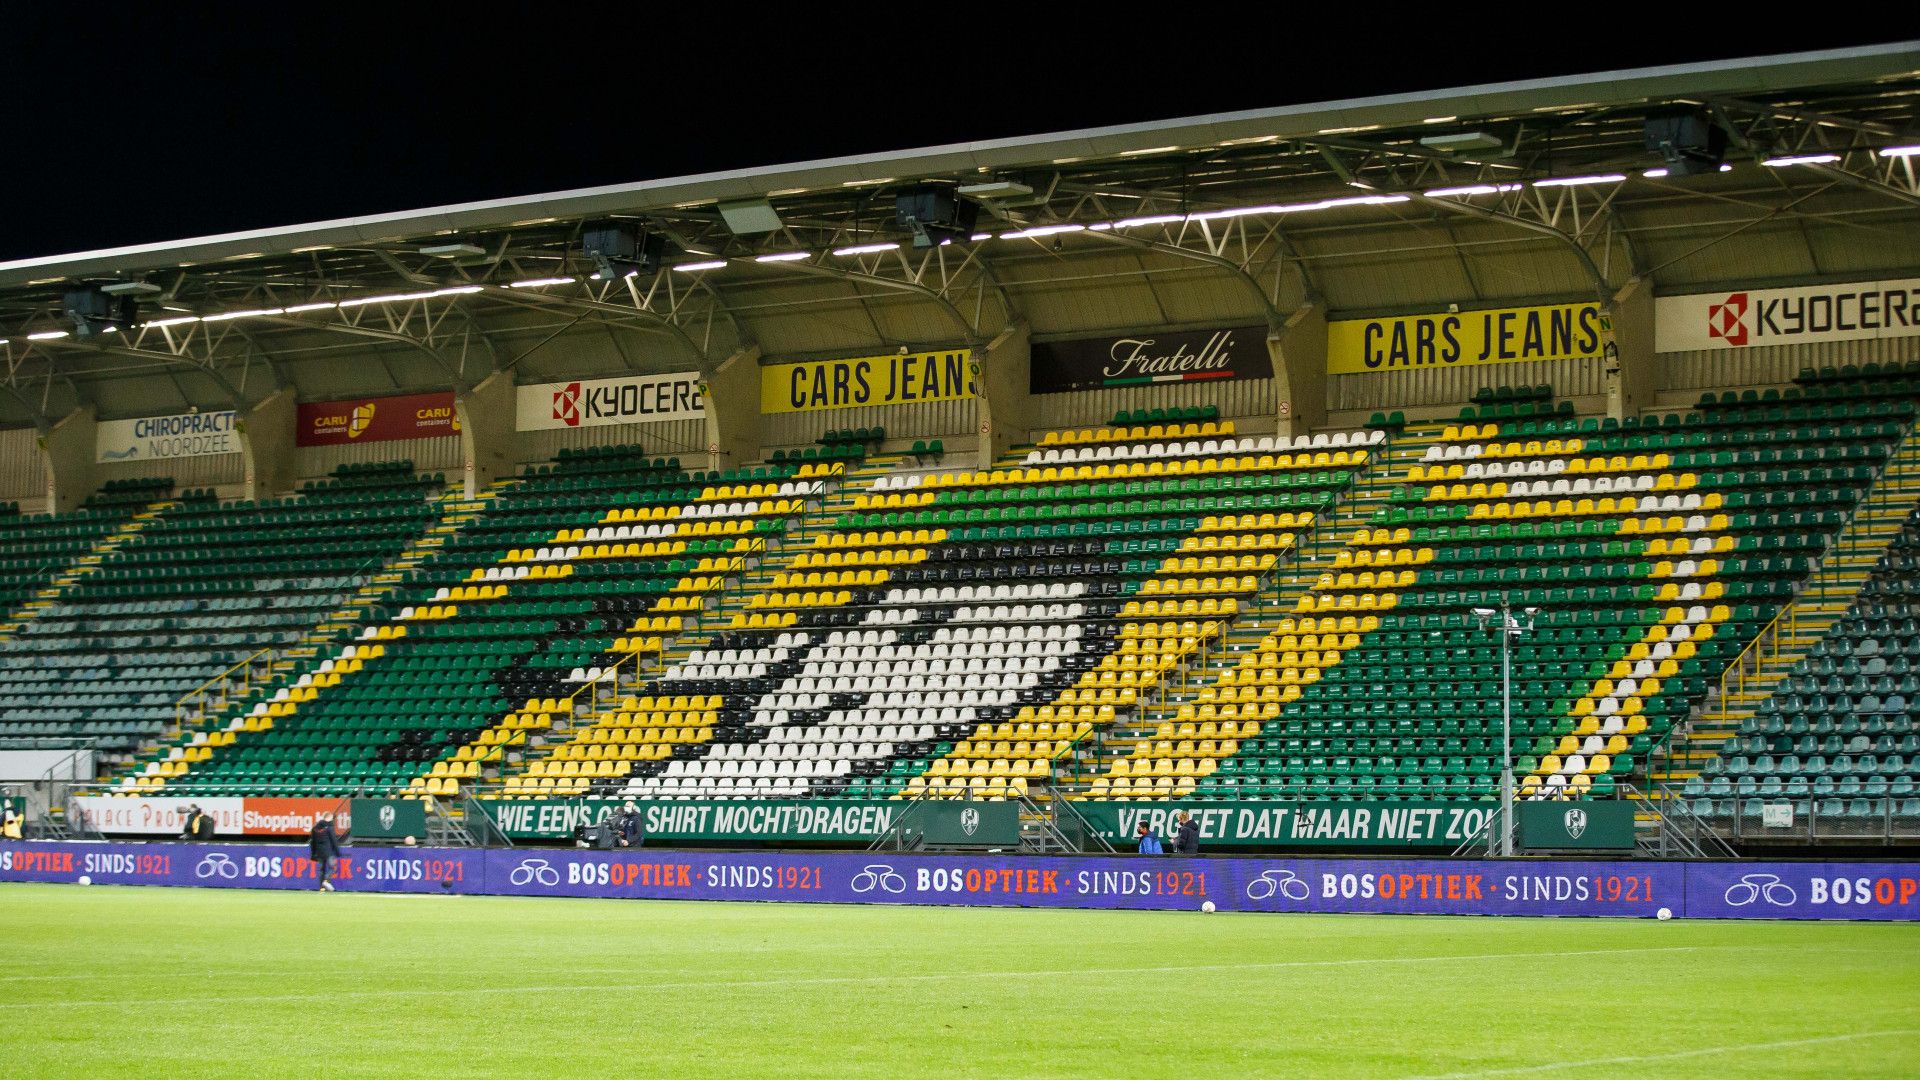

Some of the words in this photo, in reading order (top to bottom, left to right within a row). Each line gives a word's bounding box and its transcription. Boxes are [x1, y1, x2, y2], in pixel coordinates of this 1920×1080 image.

[1364, 316, 1461, 369] CARS
[1479, 306, 1598, 361] JEANS
[1103, 330, 1235, 377] Fratelli
[791, 361, 871, 408] CARS
[885, 353, 976, 401] JEAN
[314, 415, 347, 427] CARU
[416, 407, 450, 419] CARU
[416, 419, 450, 427] containers
[314, 427, 347, 435] containers
[140, 803, 239, 828] PROMADE
[244, 811, 312, 832] Shopping
[497, 805, 535, 832] WIE
[537, 805, 592, 832] EENS
[646, 805, 712, 833] SHIRT
[713, 806, 795, 833] MOCHT
[1236, 808, 1289, 838] DAT
[1291, 808, 1371, 839] MAAR
[1377, 808, 1443, 839] NIET
[1810, 877, 1920, 905] BOSOP
